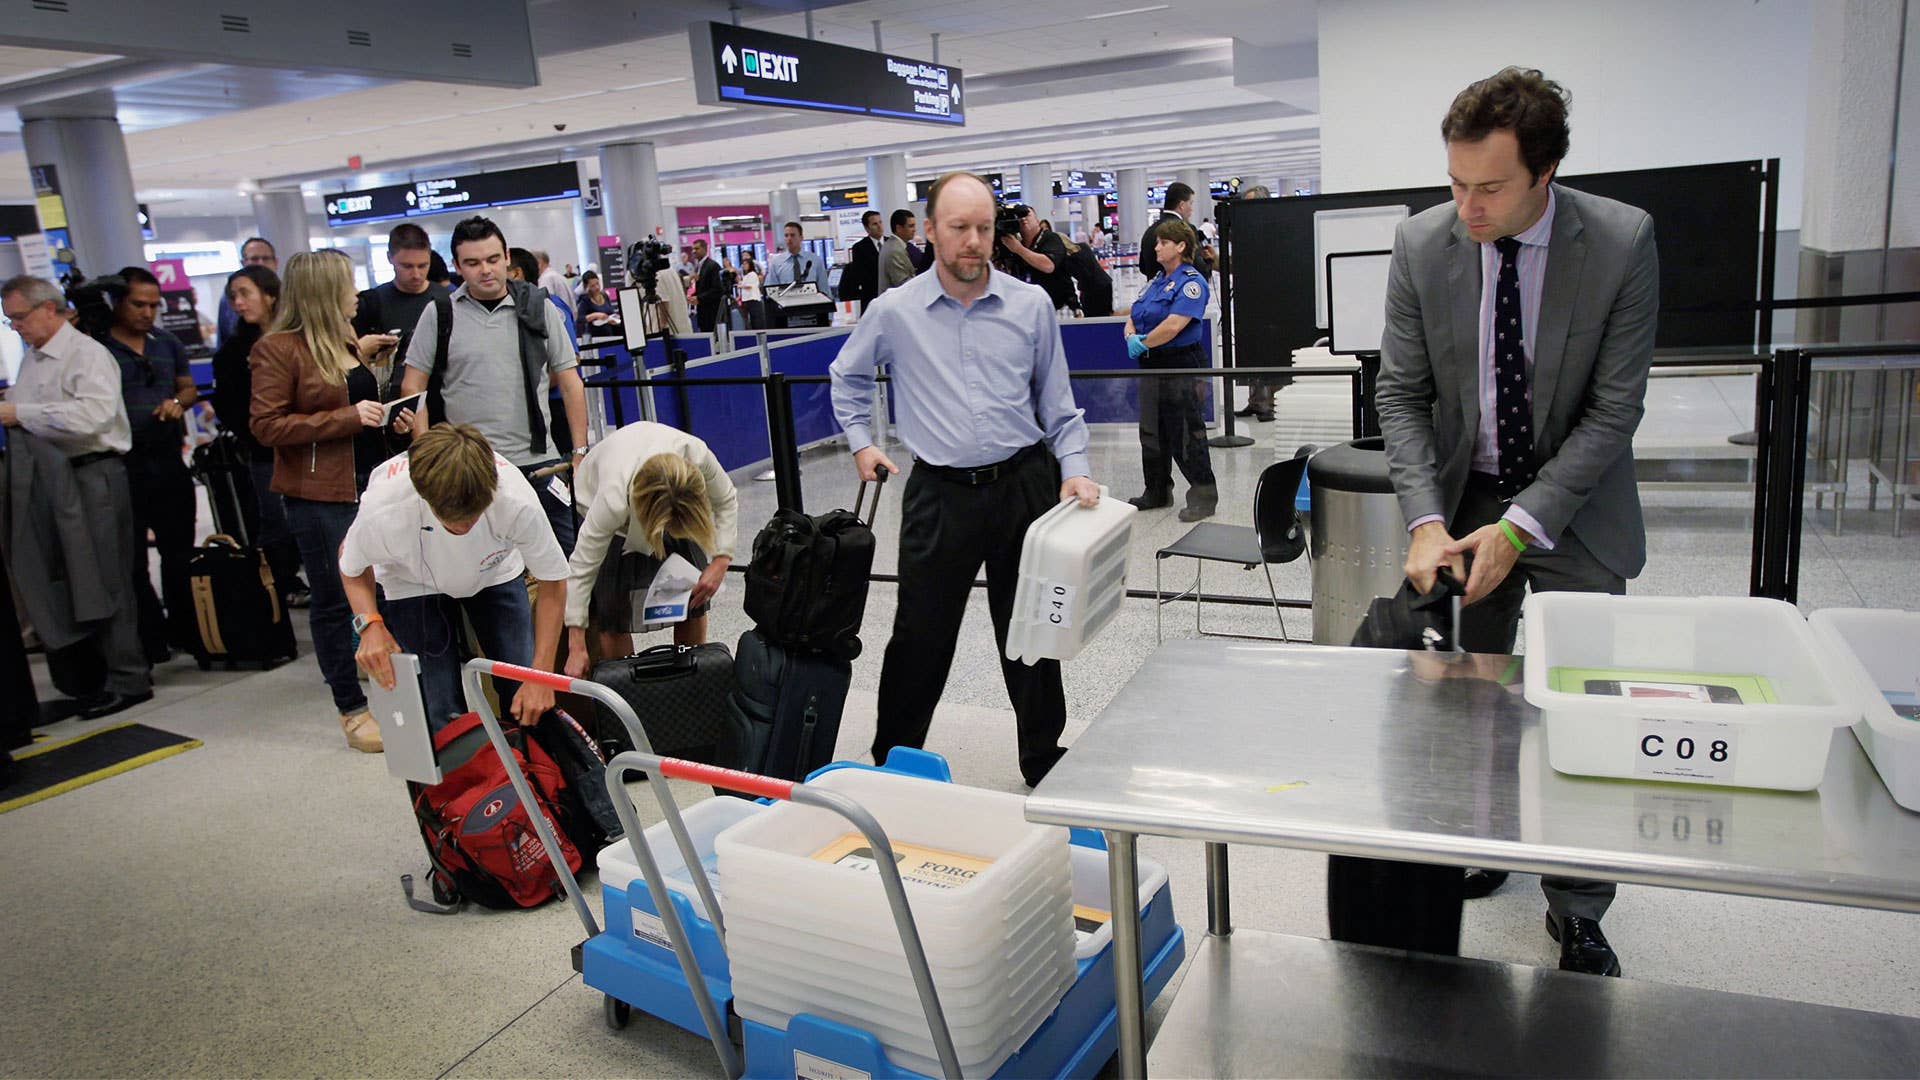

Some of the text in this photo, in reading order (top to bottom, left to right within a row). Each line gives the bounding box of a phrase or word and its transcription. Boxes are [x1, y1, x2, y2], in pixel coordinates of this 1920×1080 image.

[760, 52, 799, 83] EXIT
[887, 59, 918, 78] Baggage
[348, 196, 372, 212] EXIT
